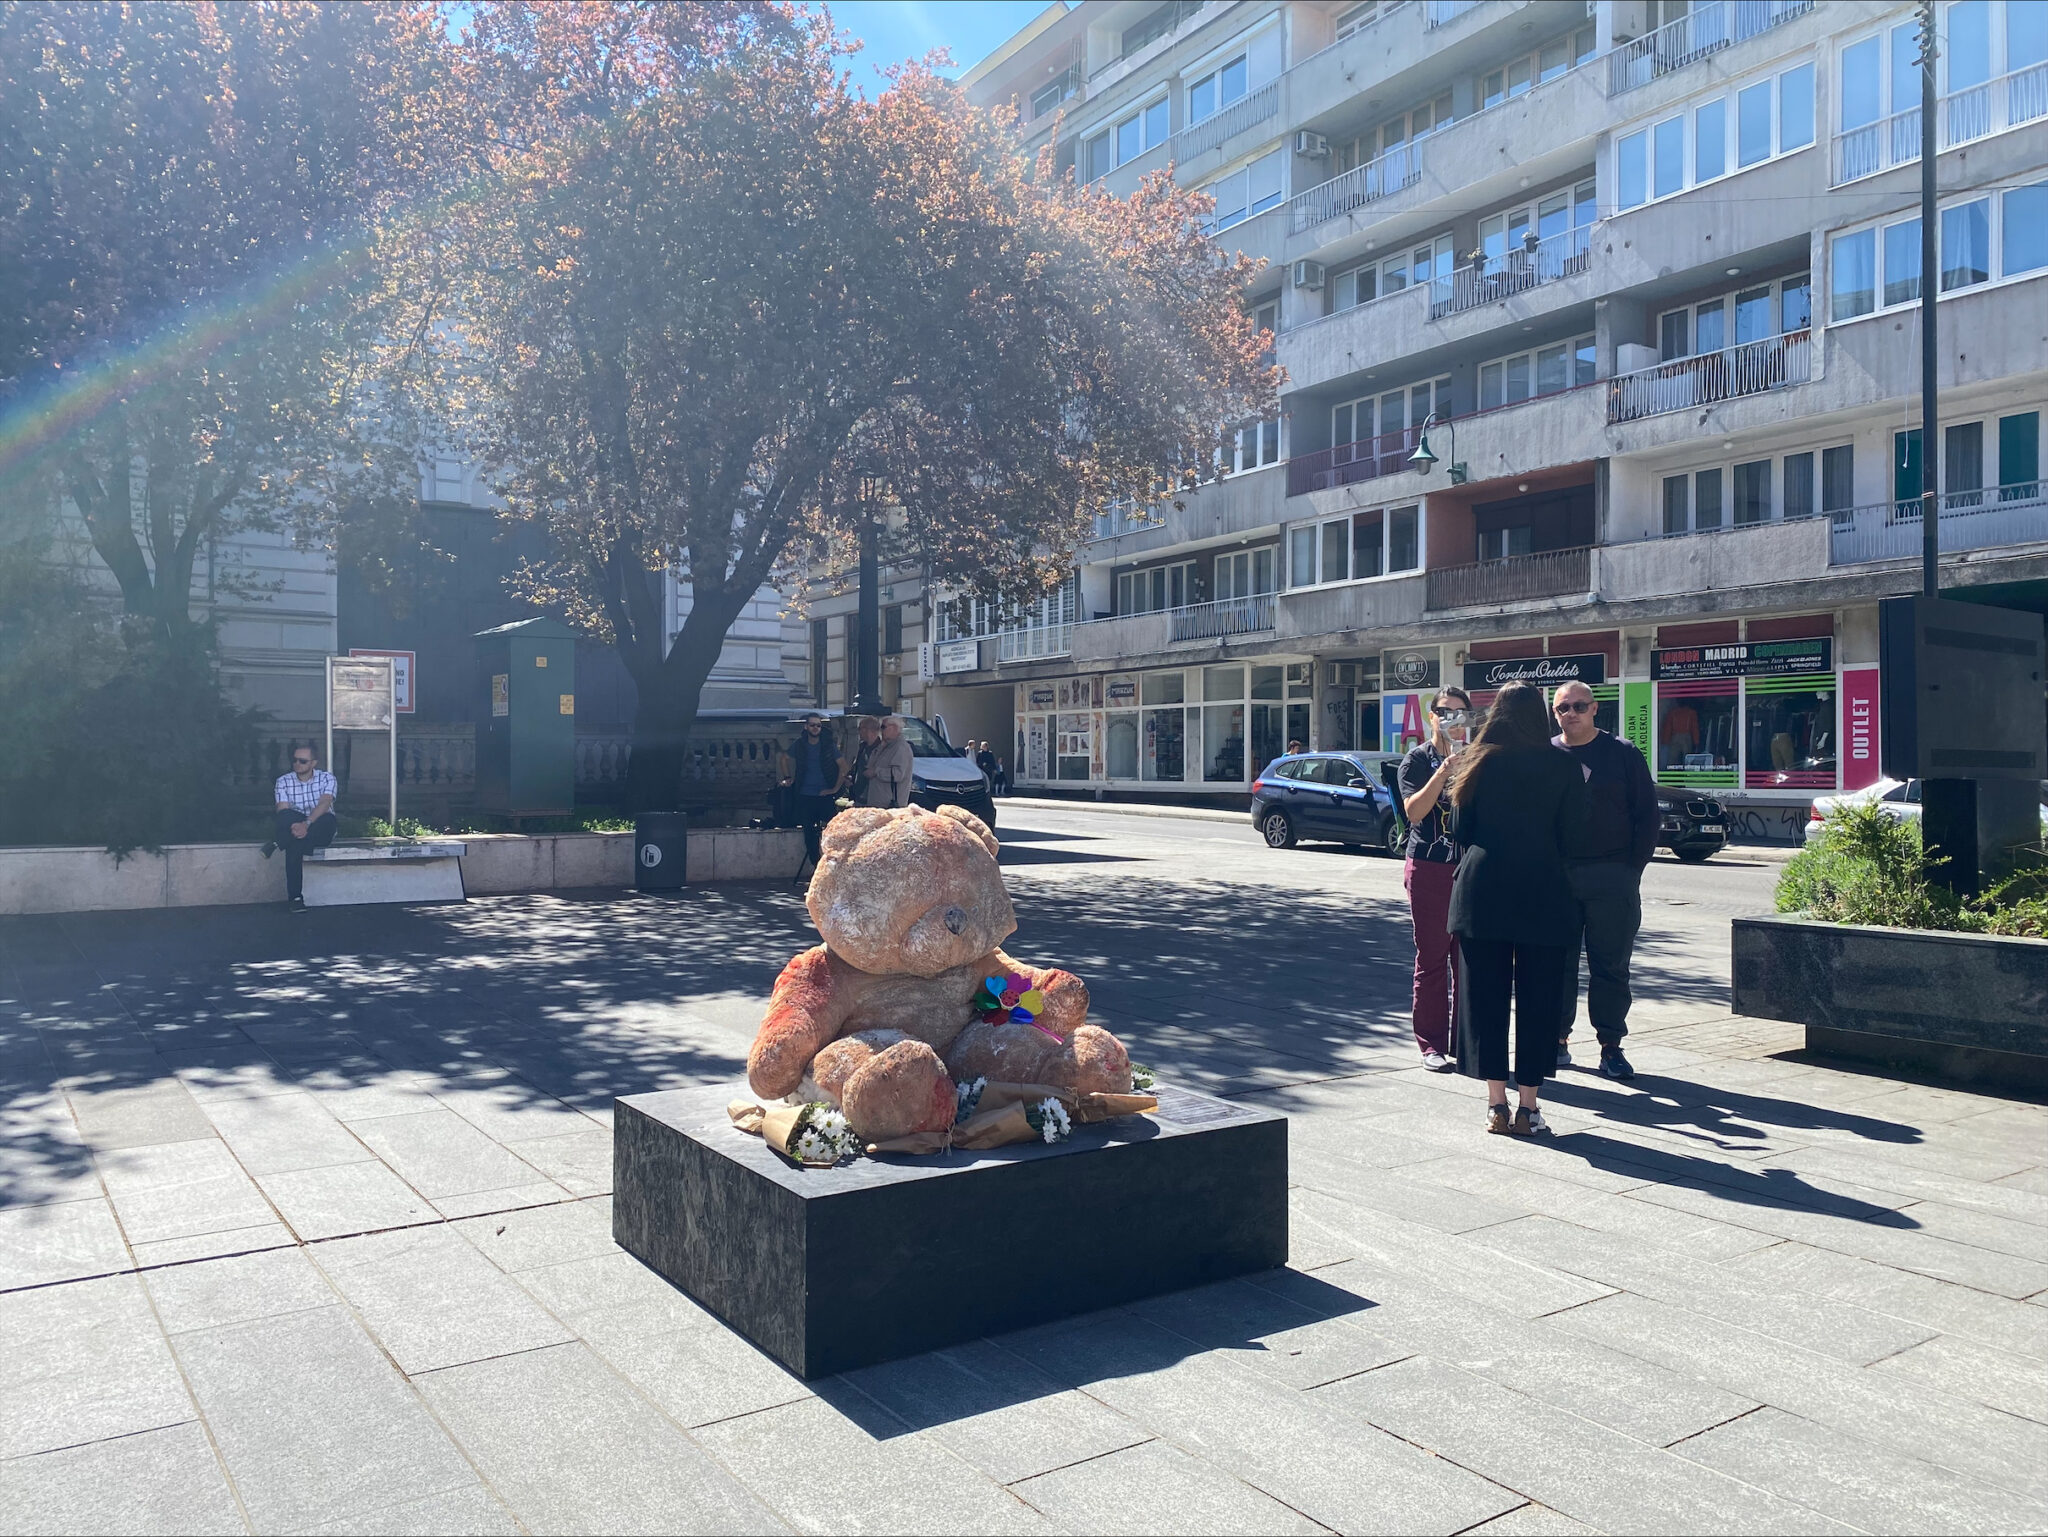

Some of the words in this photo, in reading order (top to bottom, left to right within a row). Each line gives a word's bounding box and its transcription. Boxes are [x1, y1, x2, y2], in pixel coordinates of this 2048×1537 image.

[1659, 650, 1699, 664] LONDON
[1704, 647, 1748, 661] MADRID
[1628, 715, 1636, 731] DAN
[1640, 704, 1648, 744] KOLEKCIJA
[1852, 697, 1870, 759] OUTLET
